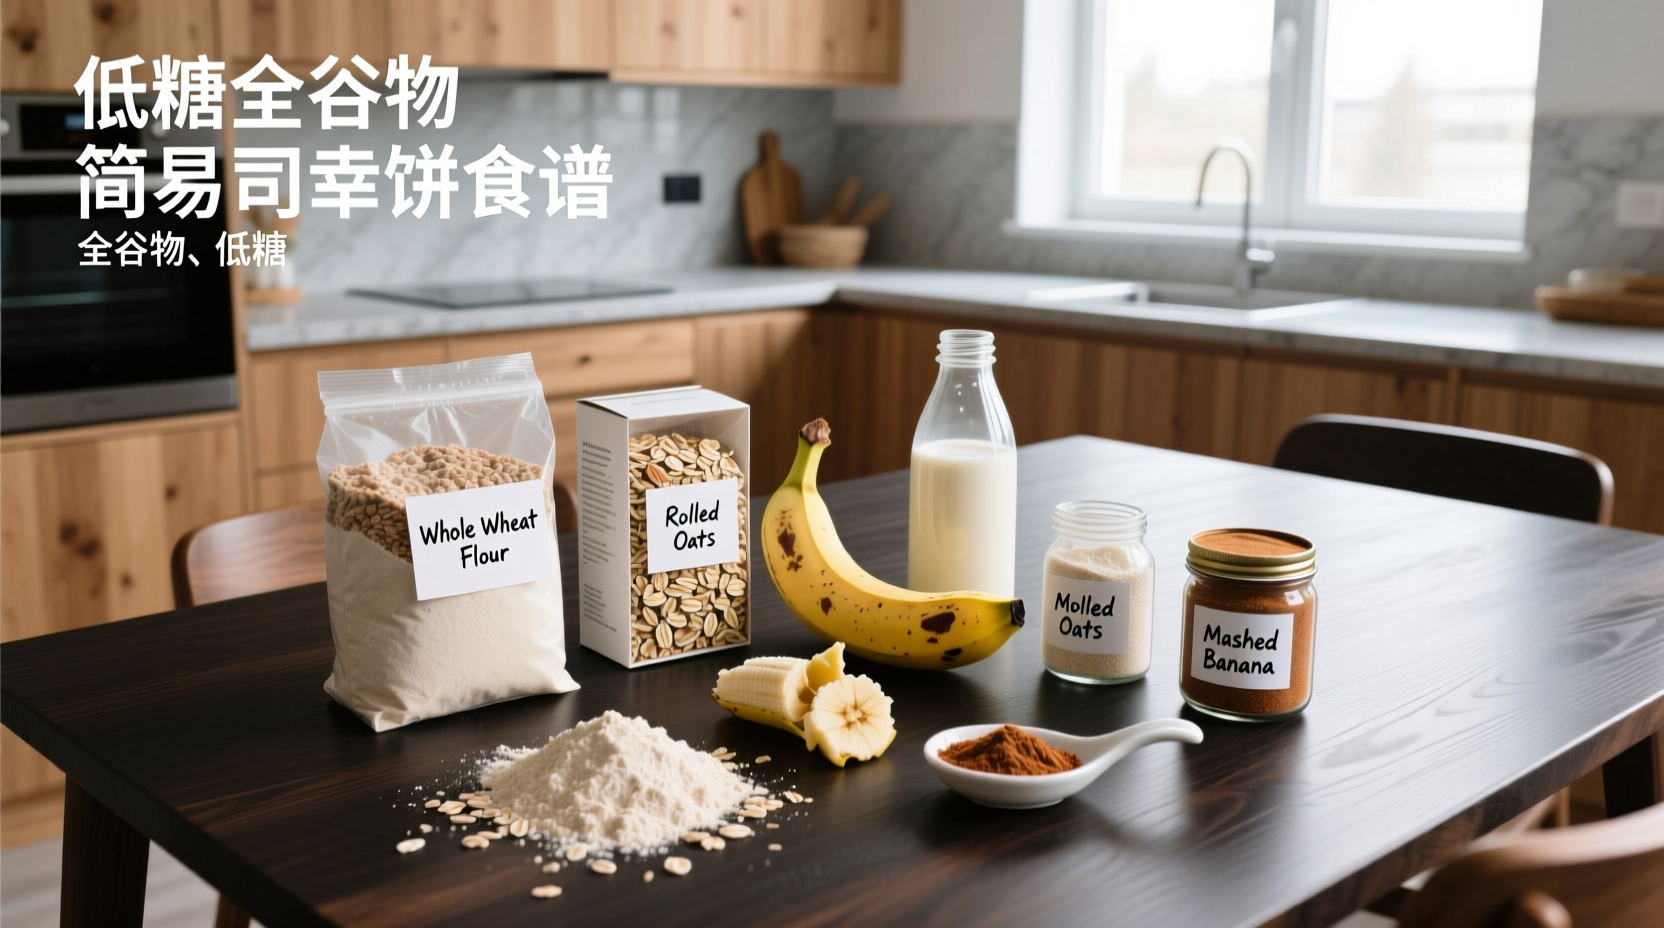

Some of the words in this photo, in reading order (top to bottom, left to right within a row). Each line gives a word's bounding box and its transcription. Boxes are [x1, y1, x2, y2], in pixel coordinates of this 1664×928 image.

[419, 516, 476, 545] Whole
[480, 508, 539, 536] Wheat
[665, 499, 720, 528] Rolled
[673, 529, 716, 551] Oats
[460, 543, 510, 569] Flour
[1054, 592, 1116, 618] Molled
[1059, 616, 1103, 640] Oats
[1203, 624, 1279, 651] Mashed
[1203, 647, 1275, 675] Banana
